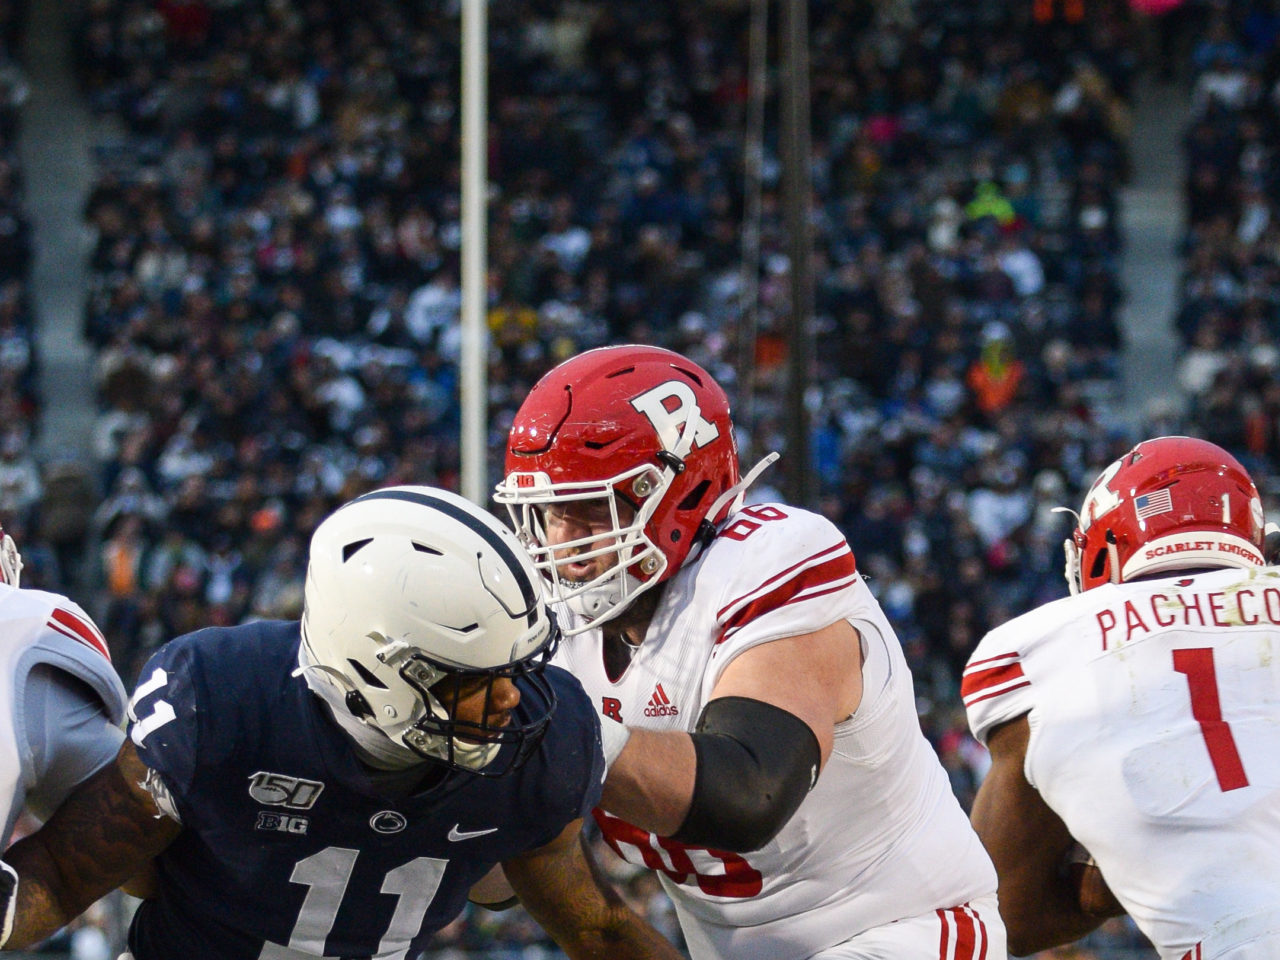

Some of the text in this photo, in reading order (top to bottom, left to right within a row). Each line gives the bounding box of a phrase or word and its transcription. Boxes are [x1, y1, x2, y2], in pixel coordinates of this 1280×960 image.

[630, 380, 720, 460] R
[1221, 493, 1231, 524] 1
[1145, 541, 1215, 560] SCARLET
[602, 696, 623, 723] R
[643, 704, 679, 718] adidas
[1172, 647, 1250, 793] 1
